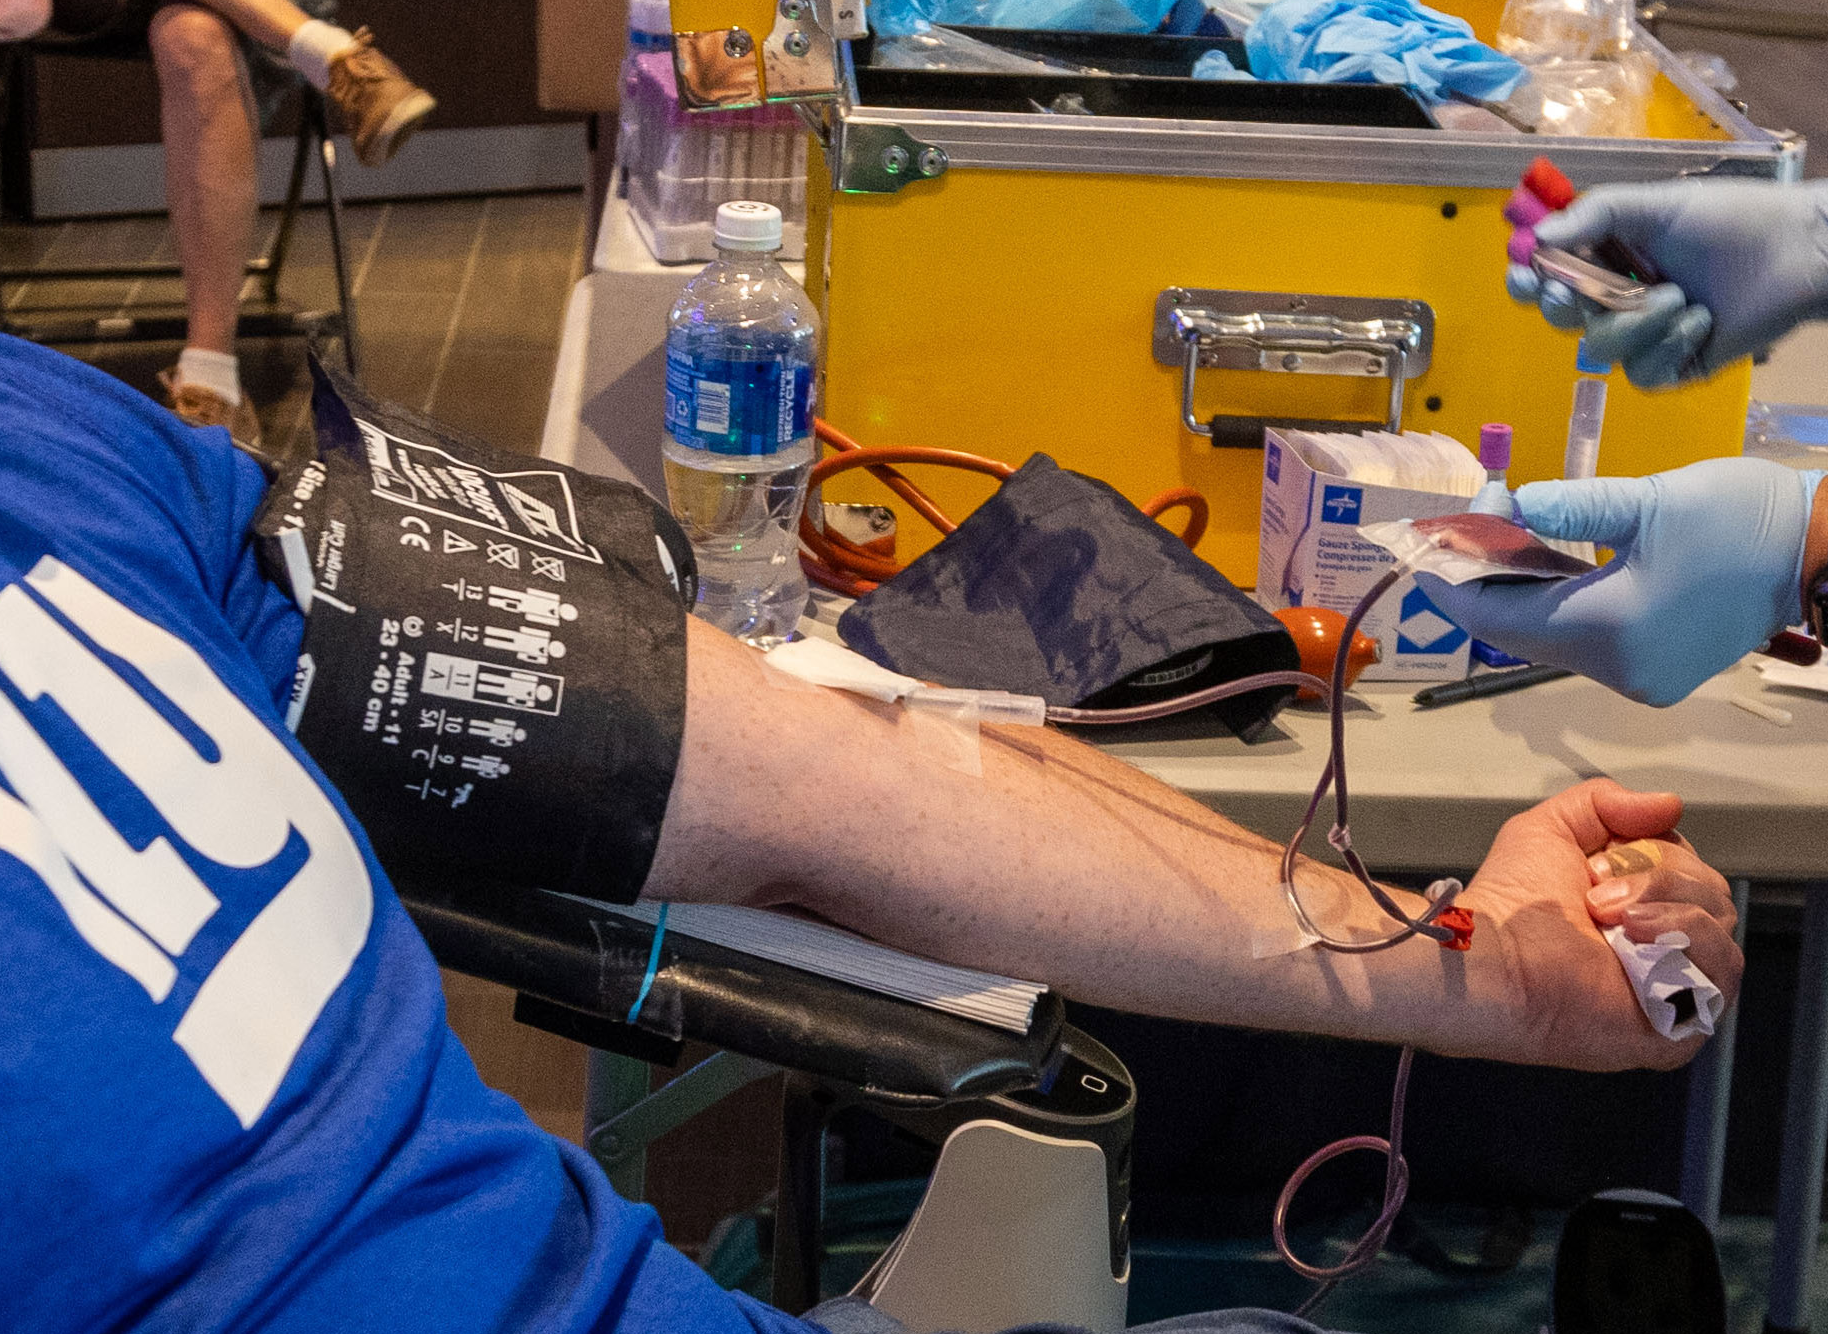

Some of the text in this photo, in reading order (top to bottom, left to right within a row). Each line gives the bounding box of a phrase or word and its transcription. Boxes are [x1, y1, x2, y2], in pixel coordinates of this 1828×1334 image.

[784, 369, 796, 441] RECYCLE
[293, 467, 327, 501] Size
[329, 519, 347, 548] Cuff
[1318, 537, 1349, 550] Gauze
[1317, 549, 1377, 563] Compresses
[320, 547, 343, 591] Larger
[440, 582, 459, 593] T
[465, 584, 484, 601] 13
[435, 620, 455, 635] X
[460, 625, 480, 643] 12
[362, 617, 400, 733] 23 40 cm
[428, 668, 446, 680] A
[454, 672, 472, 688] 11
[381, 651, 417, 745] Adult 11
[418, 708, 440, 730] SA
[444, 716, 464, 734] 10
[410, 748, 431, 761] C
[437, 753, 456, 766] 9
[429, 785, 447, 798] 7
